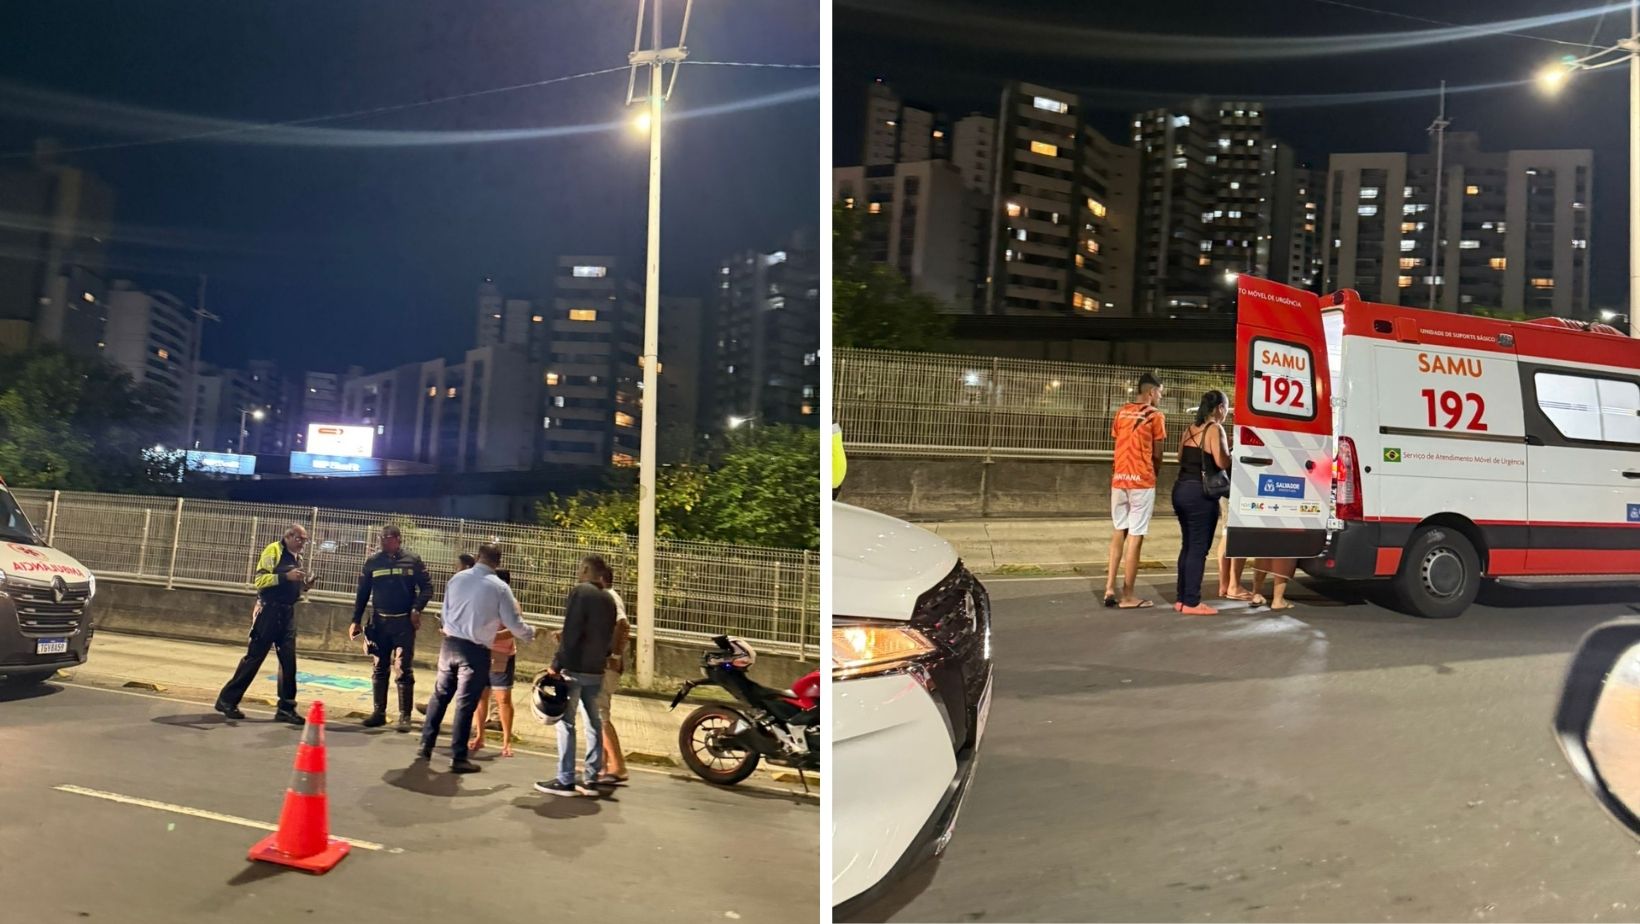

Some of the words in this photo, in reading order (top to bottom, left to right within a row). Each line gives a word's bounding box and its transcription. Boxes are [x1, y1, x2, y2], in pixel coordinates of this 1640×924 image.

[1247, 289, 1267, 300] MÓVEL
[1275, 296, 1302, 308] URGÊNCIA
[1419, 328, 1444, 336] UNIDADE
[1452, 332, 1476, 340] SUPORTE
[1261, 350, 1306, 371] SAMU
[1418, 352, 1483, 378] SAMU
[1261, 375, 1305, 408] 192
[1421, 388, 1488, 431] 192
[1403, 451, 1426, 460] Serviço
[1426, 452, 1434, 460] de
[1435, 453, 1473, 463] Atendimento
[1474, 455, 1492, 464] Móvel
[1492, 456, 1500, 464] de
[1275, 481, 1300, 490] SALVADOR
